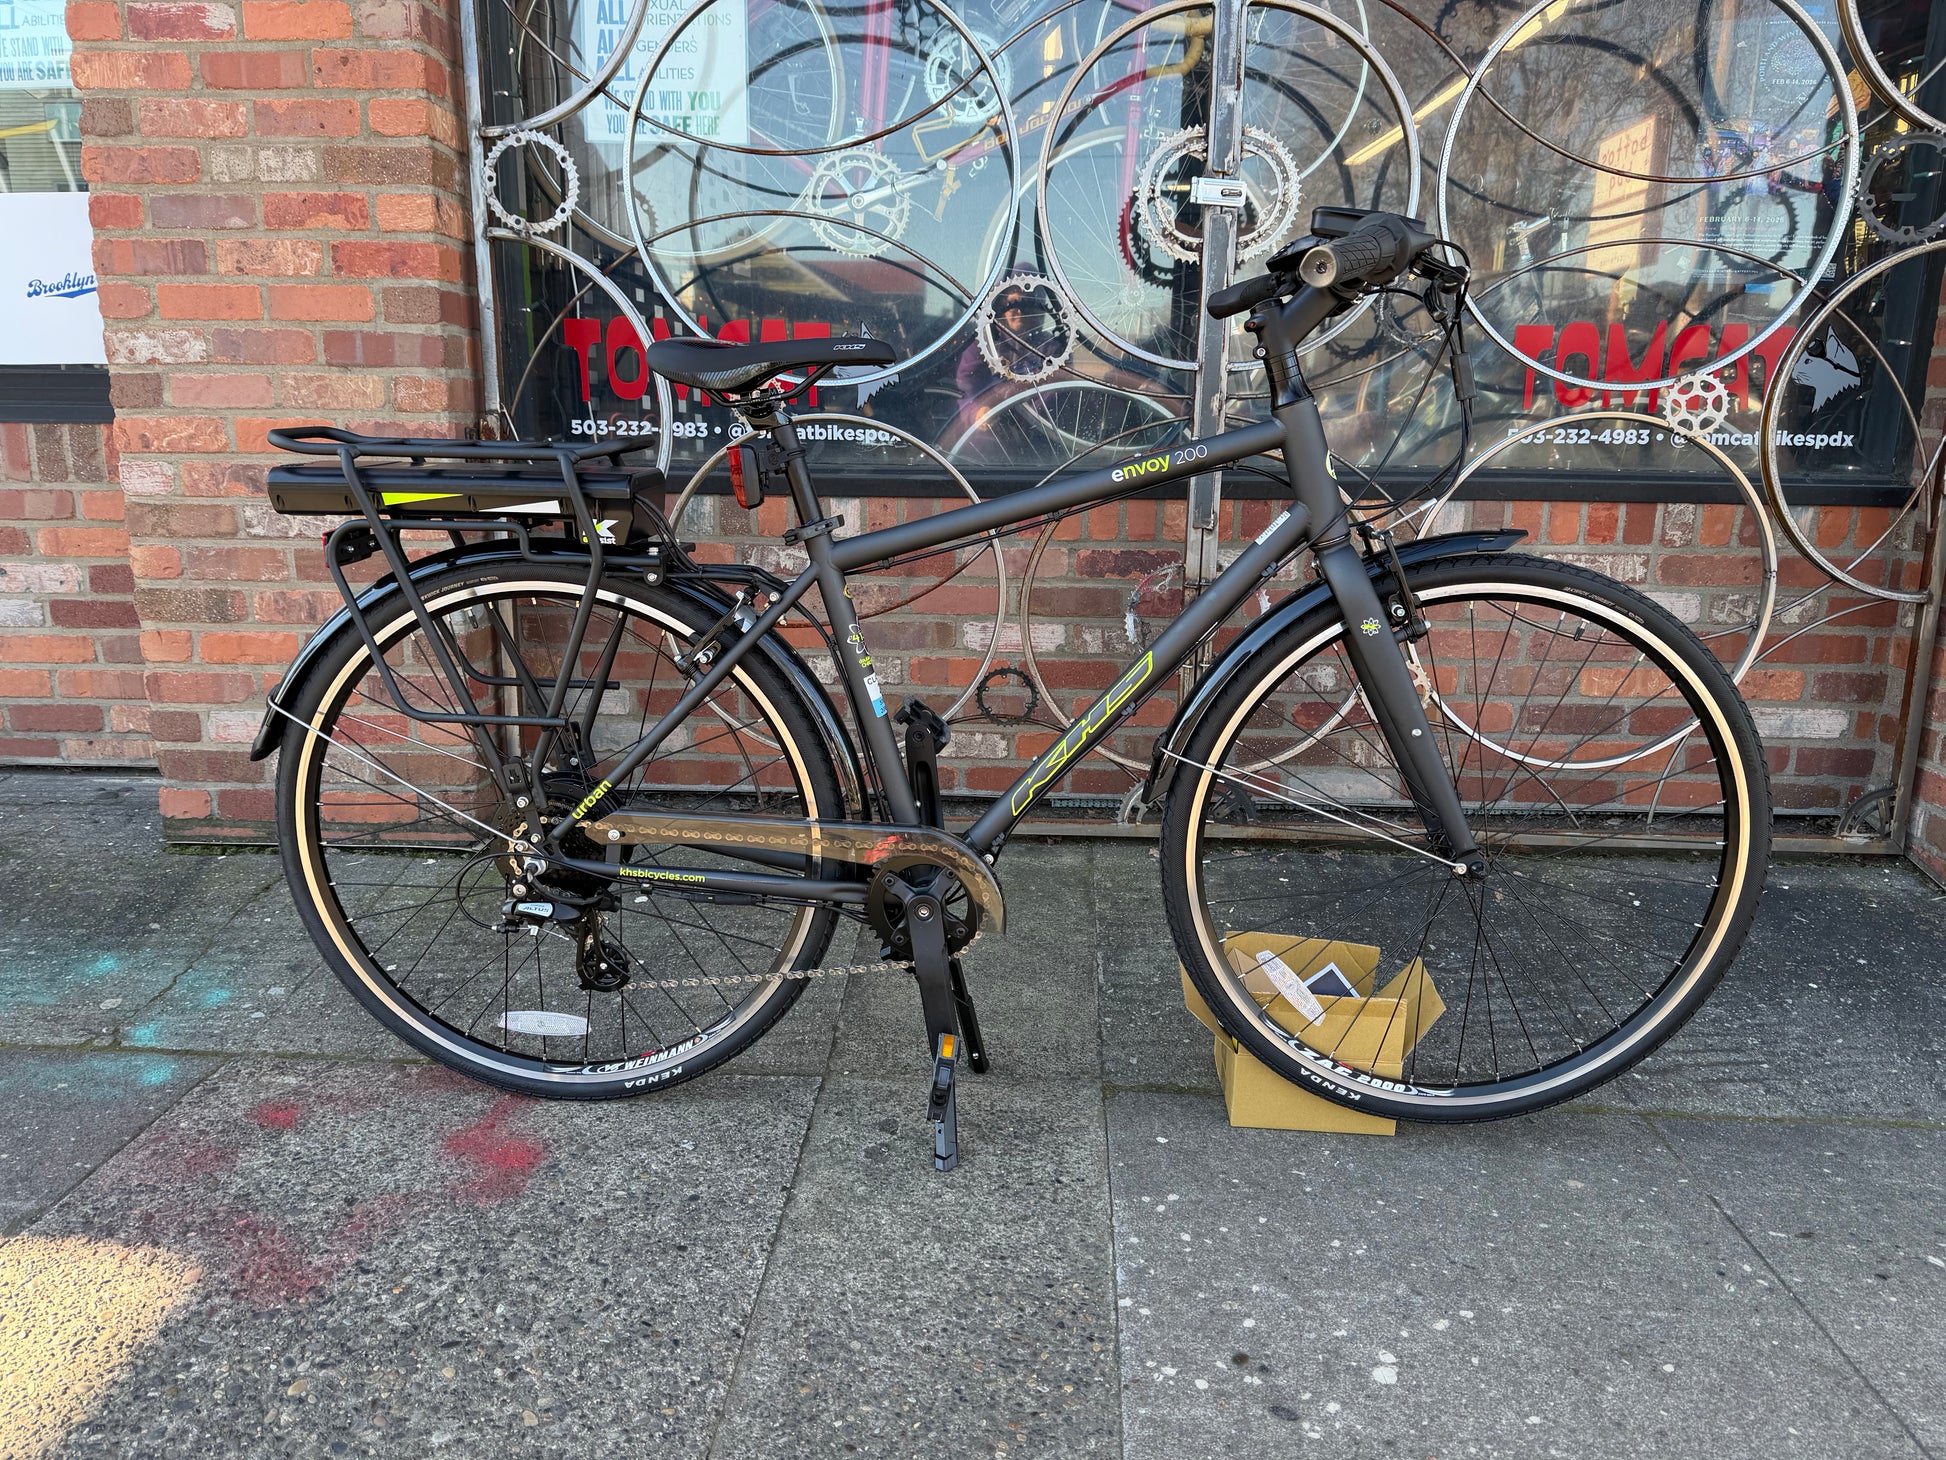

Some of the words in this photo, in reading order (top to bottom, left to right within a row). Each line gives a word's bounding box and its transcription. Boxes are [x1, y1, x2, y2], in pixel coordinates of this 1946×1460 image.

[647, 0, 688, 11] XUAL
[22, 14, 65, 27] ABILITIE
[647, 13, 732, 26] RIENTIONS
[11, 37, 39, 58] STAND
[42, 36, 64, 56] WITH
[636, 39, 698, 53] GEERS
[18, 61, 34, 81] ARE
[624, 90, 655, 110] STND
[659, 90, 682, 111] WITH
[688, 90, 720, 111] YOU
[607, 114, 625, 134] YOU
[696, 115, 720, 135] HERE
[26, 272, 95, 298] Brooklyn
[571, 419, 708, 438] 503-232-983
[1111, 454, 1170, 482] envoy
[1174, 444, 1208, 465] 200
[571, 780, 613, 820] urban
[619, 867, 705, 883] khsbicycles.com
[624, 1039, 694, 1071] WEINMANN
[624, 1066, 683, 1089] KENDA
[1300, 1066, 1361, 1101] KENDA
[1356, 1073, 1406, 1094] 2000
